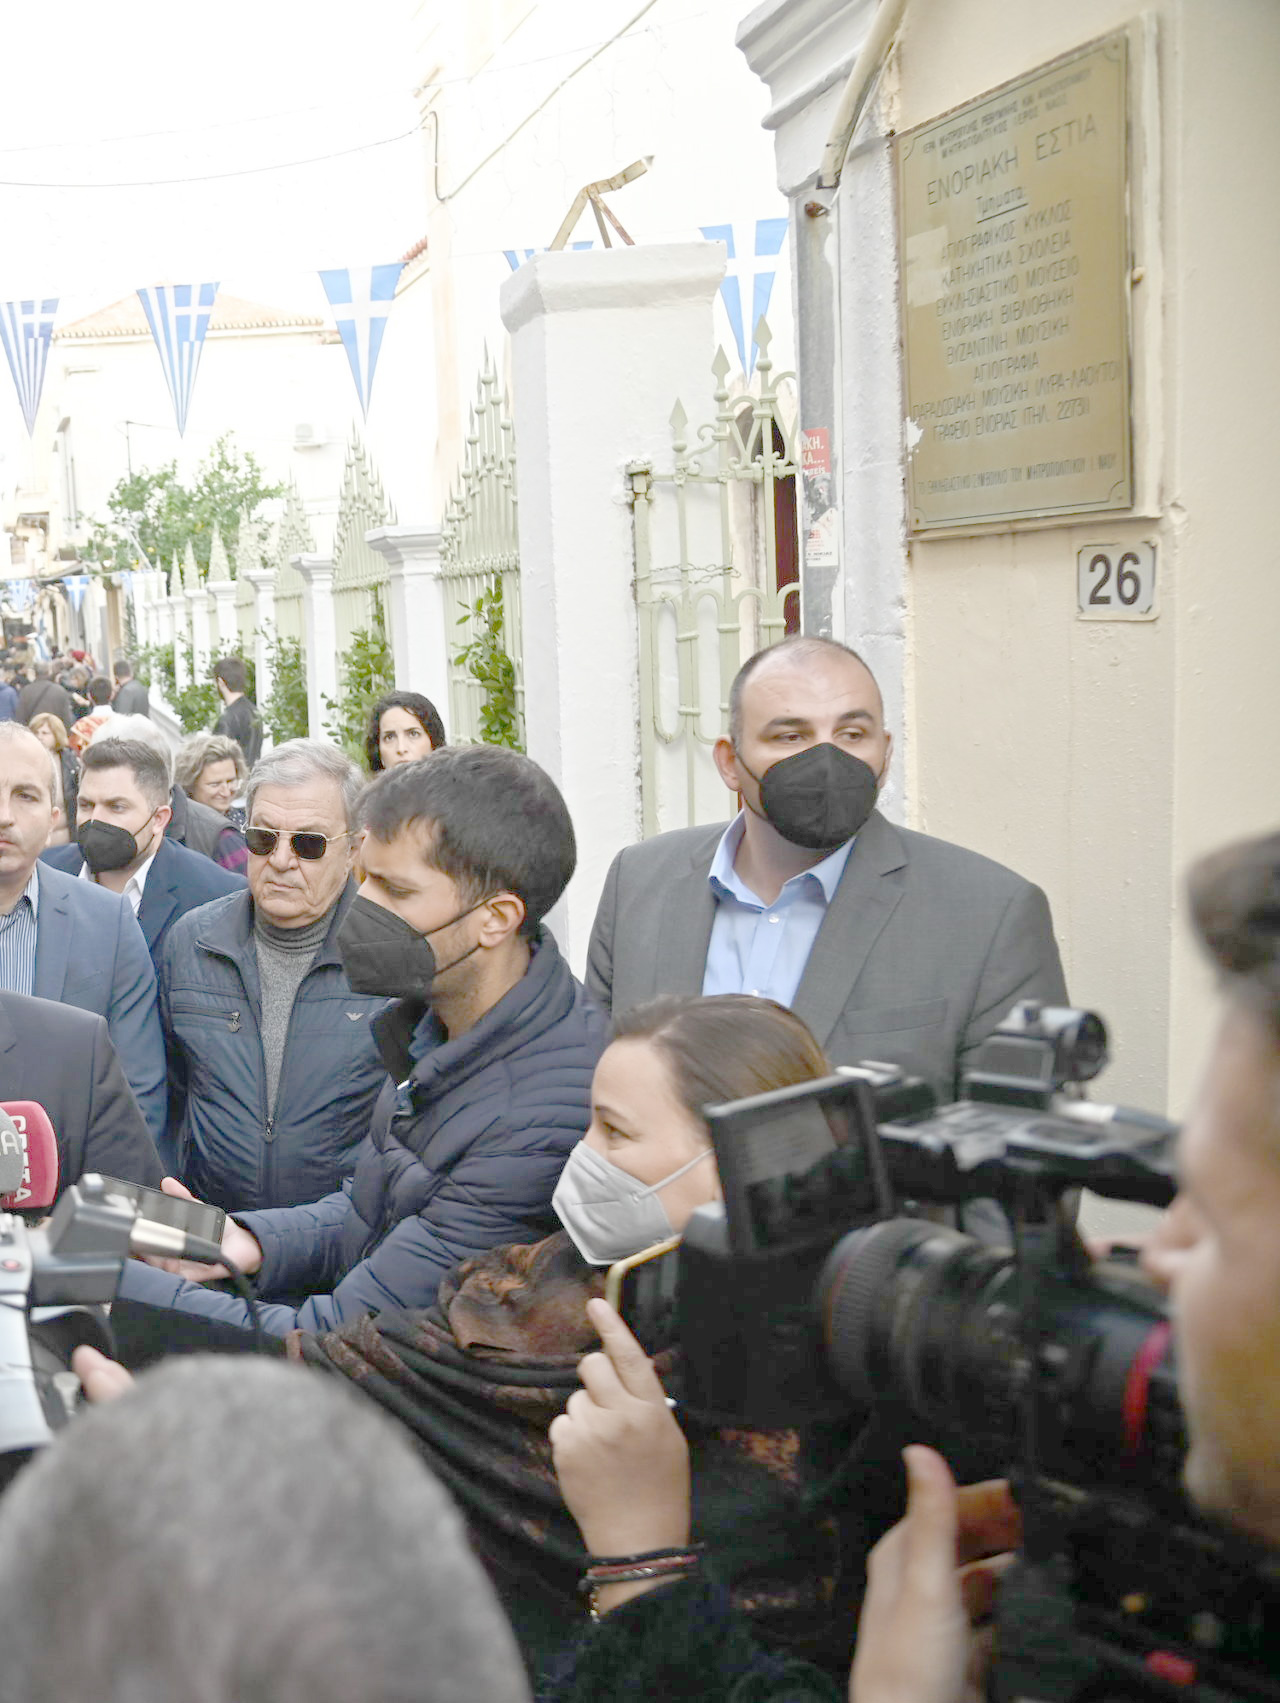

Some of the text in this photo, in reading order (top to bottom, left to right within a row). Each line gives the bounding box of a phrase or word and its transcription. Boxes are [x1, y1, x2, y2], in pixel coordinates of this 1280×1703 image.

[927, 112, 1096, 205] ΕΝΟΡΙΑΚΗ ΕΣΤΙΑ
[941, 200, 1071, 261] ΑΓΙΟΓΡΑΦΙΚΟΣ ΚΥΚΛΟΣ
[936, 255, 1079, 315] ΕΚΚΛΗΣΙΑΣΤΙΚΟ ΜΟΥΣΕΙΟ
[942, 230, 1070, 288] ΚΑΤΗΧΗΤΙΚΑ ΣΧΟΛΕΙΑ
[943, 286, 1073, 339] ΕΝΟΡΙΑΚΗ ΒΙΒΛΙΟΘΗΚΗ
[947, 315, 1069, 364] ΒΥΖΑΝΤΙΝΗ ΜΟΥΣΙΚΗ
[974, 351, 1038, 382] ΑΓΙΟΓΡΑΦΙΑ
[982, 381, 1028, 406] ΜΟΥΣΙΚΗ
[933, 420, 969, 442] ΓΡΑΦΕΙΟ
[976, 410, 1017, 434] ΕΝΟΡΙΑΣ
[1089, 552, 1141, 606] 26
